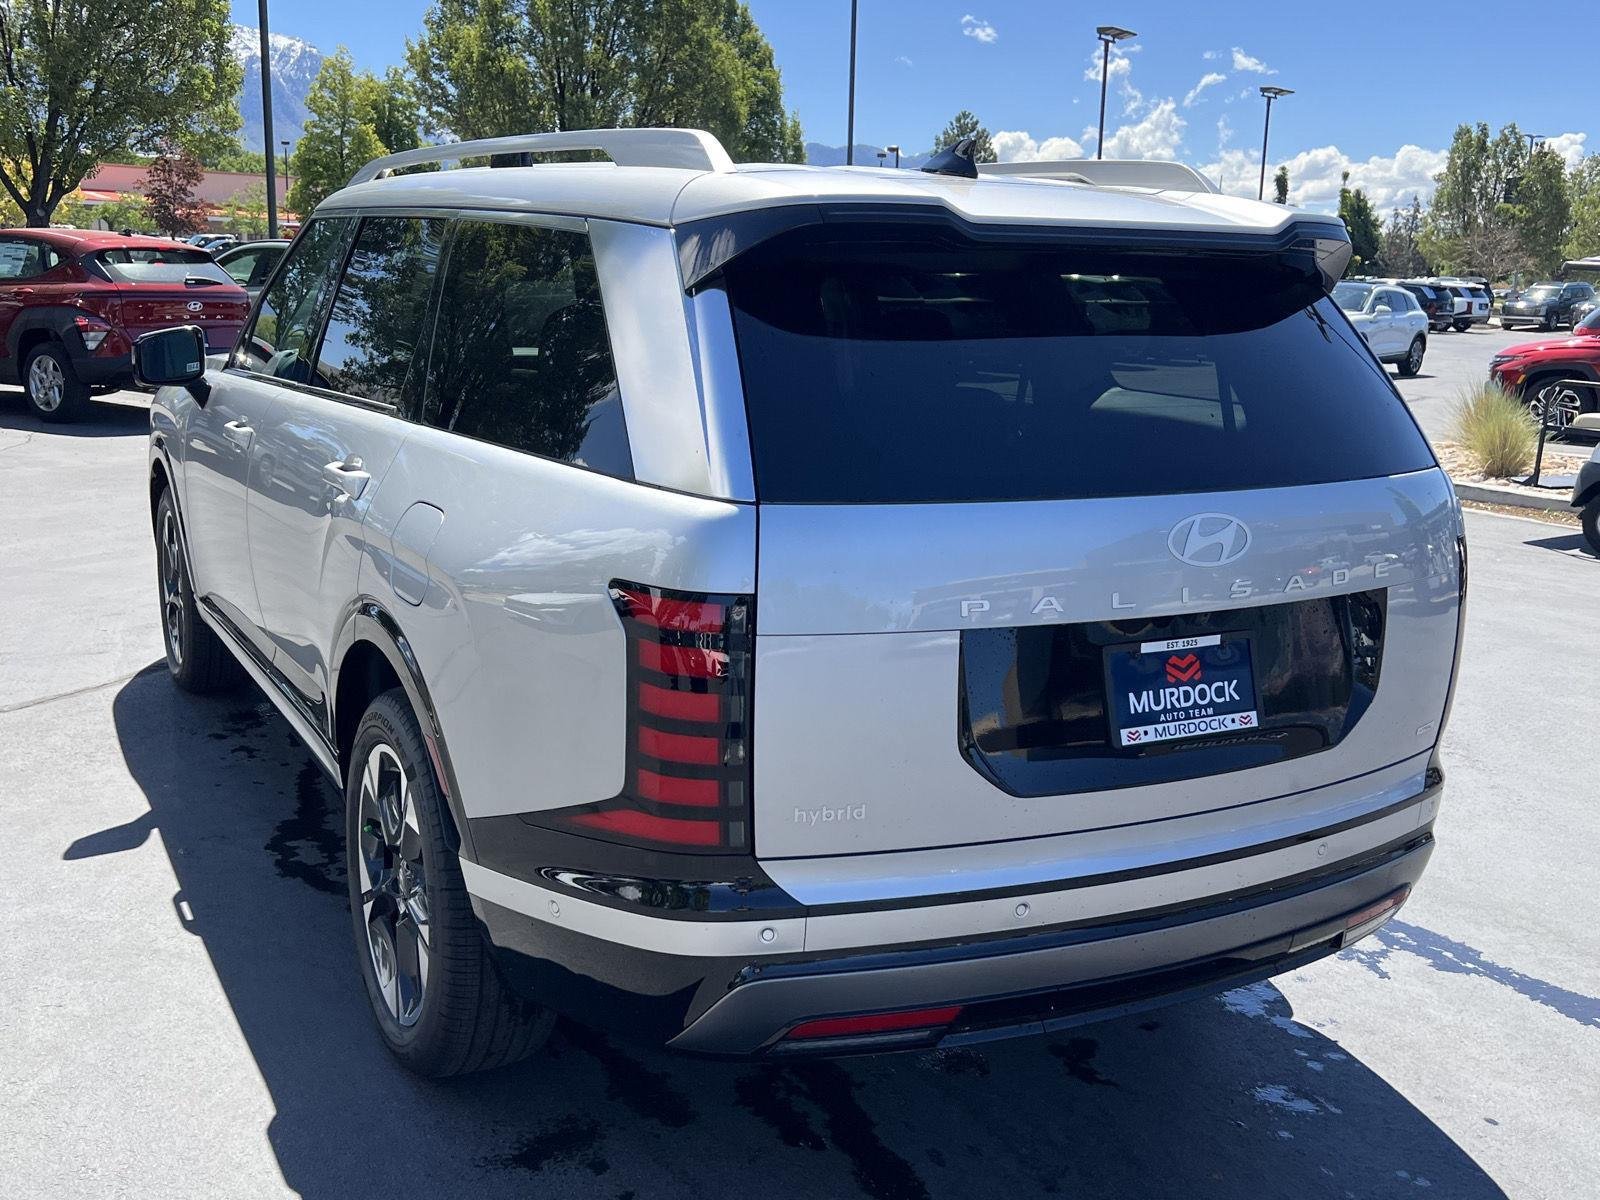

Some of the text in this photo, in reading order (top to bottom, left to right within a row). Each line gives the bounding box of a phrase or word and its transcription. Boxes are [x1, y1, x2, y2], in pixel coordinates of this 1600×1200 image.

[960, 562, 1391, 617] PALISADE
[1182, 639, 1198, 648] 1925
[1128, 679, 1240, 714] MURDOCK
[1160, 707, 1214, 722] AUTO TEAM
[1154, 717, 1228, 739] MURDOCK
[794, 804, 866, 826] hybrid
